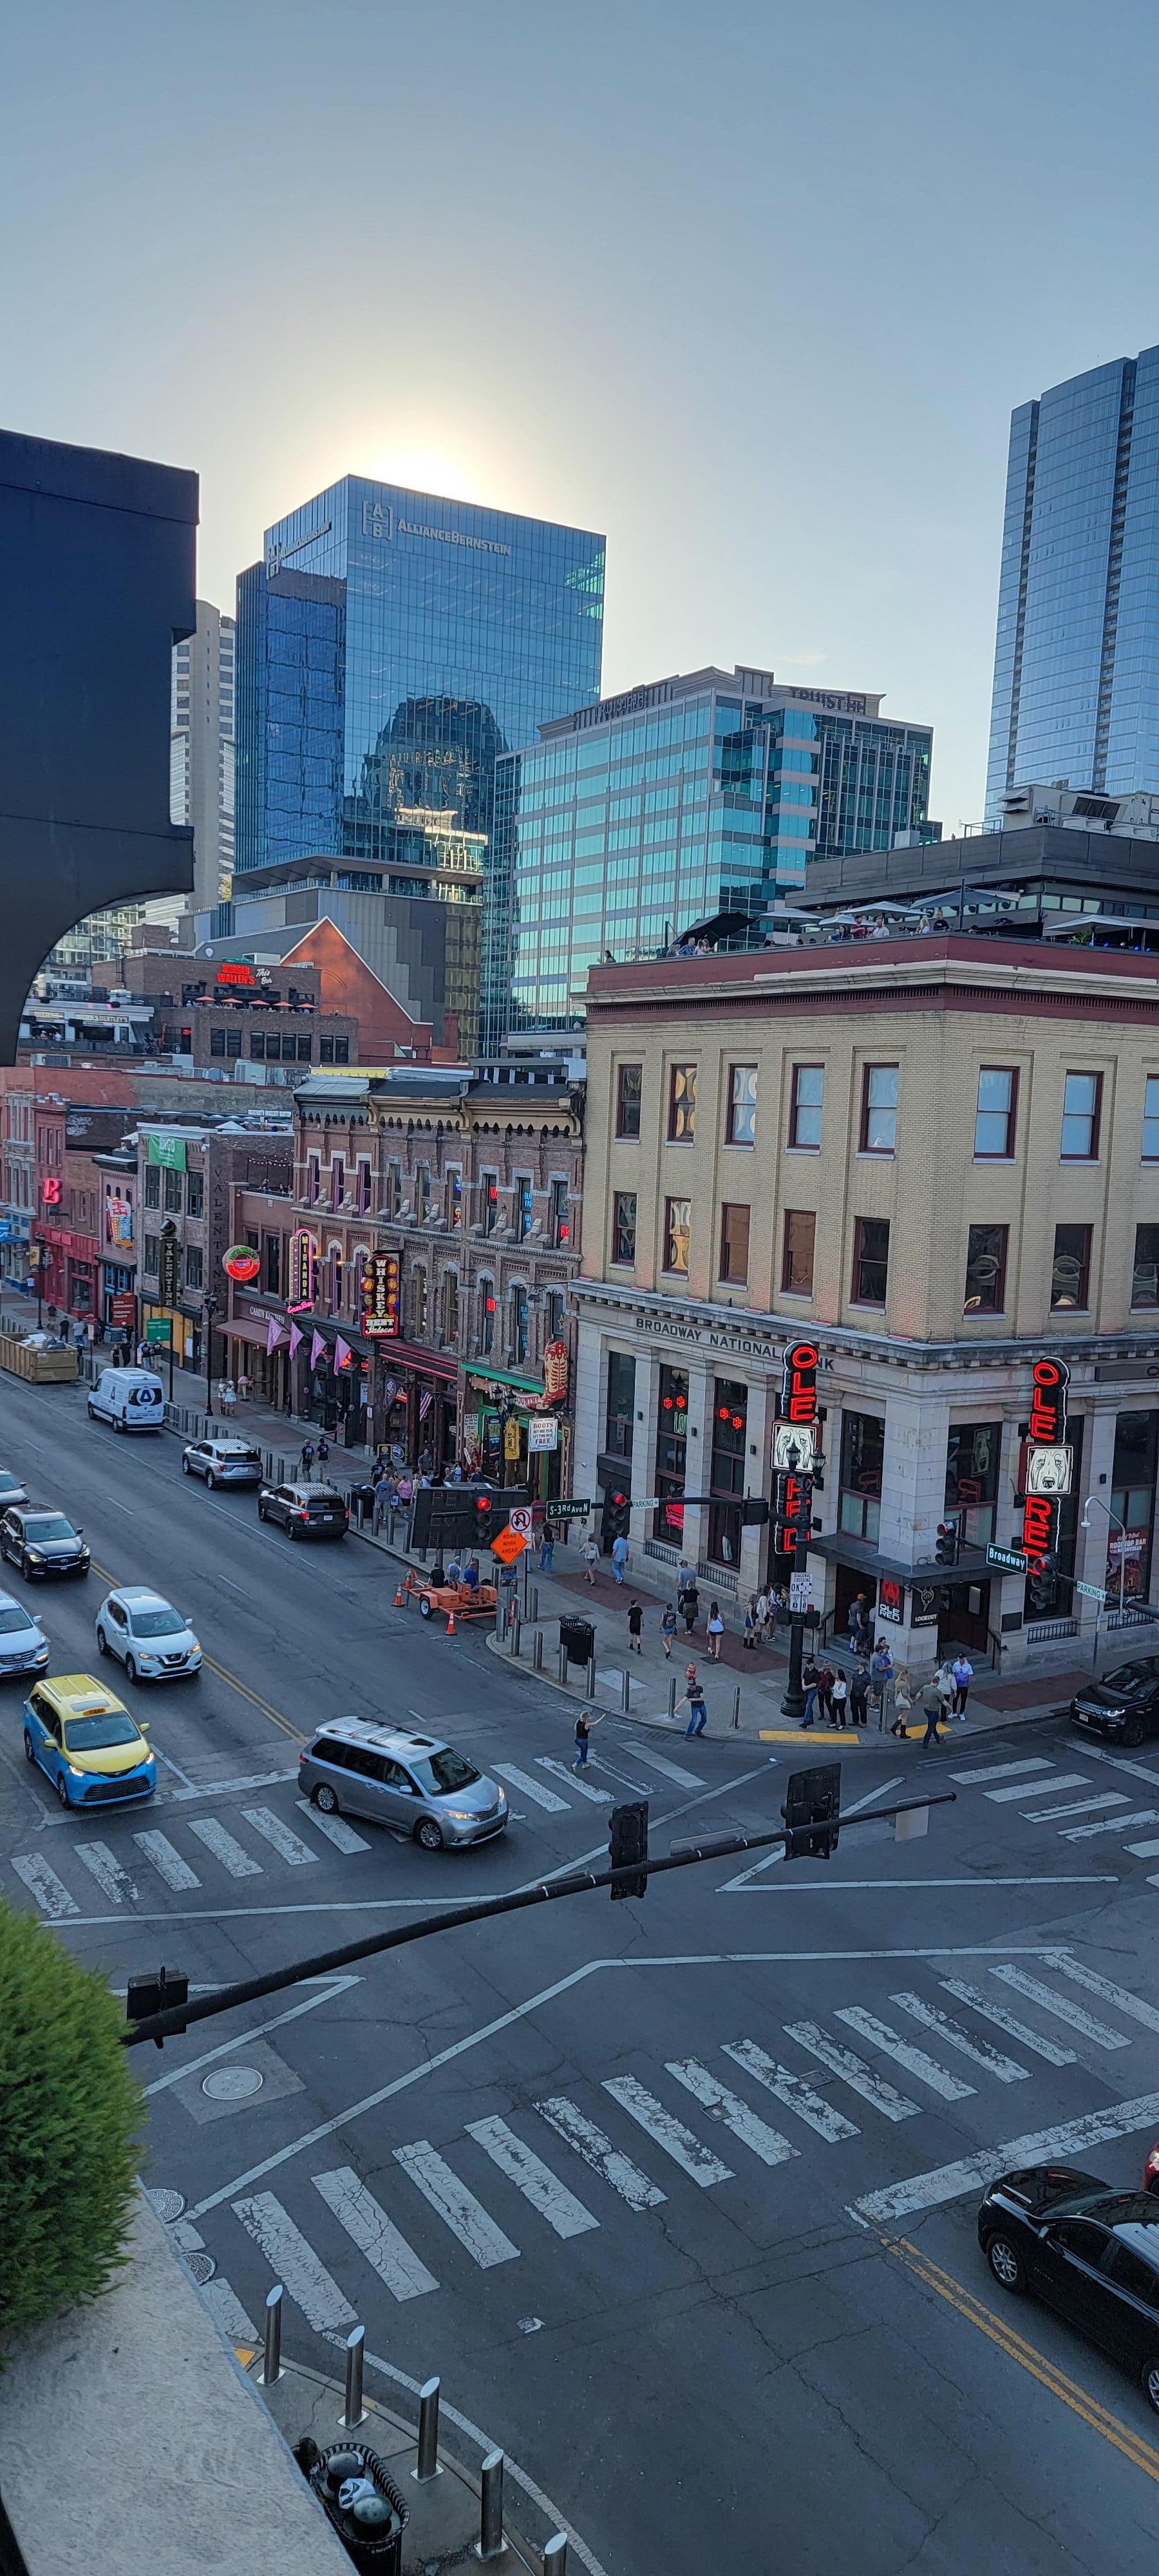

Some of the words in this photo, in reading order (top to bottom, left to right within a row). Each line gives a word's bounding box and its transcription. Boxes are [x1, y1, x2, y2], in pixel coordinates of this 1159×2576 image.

[256, 968, 270, 977] This
[213, 1170, 222, 1293] VALENTINE
[165, 1243, 173, 1306] VALENTINE
[375, 1260, 387, 1318] WHISKEY
[249, 1306, 265, 1319] CANDY
[636, 1317, 701, 1341] BROADWAY
[710, 1333, 782, 1359] NATIONAL
[817, 1357, 834, 1371] NK
[791, 1347, 817, 1421] OLE
[514, 1395, 538, 1405] OUNTRY
[1031, 1362, 1059, 1441] OLE
[633, 1499, 654, 1508] PARKING
[989, 1548, 1025, 1570] Broadway
[791, 1583, 800, 1591] OK
[1077, 1582, 1100, 1598] PARKING
[880, 1604, 900, 1613] OLE
[880, 1610, 900, 1622] RED
